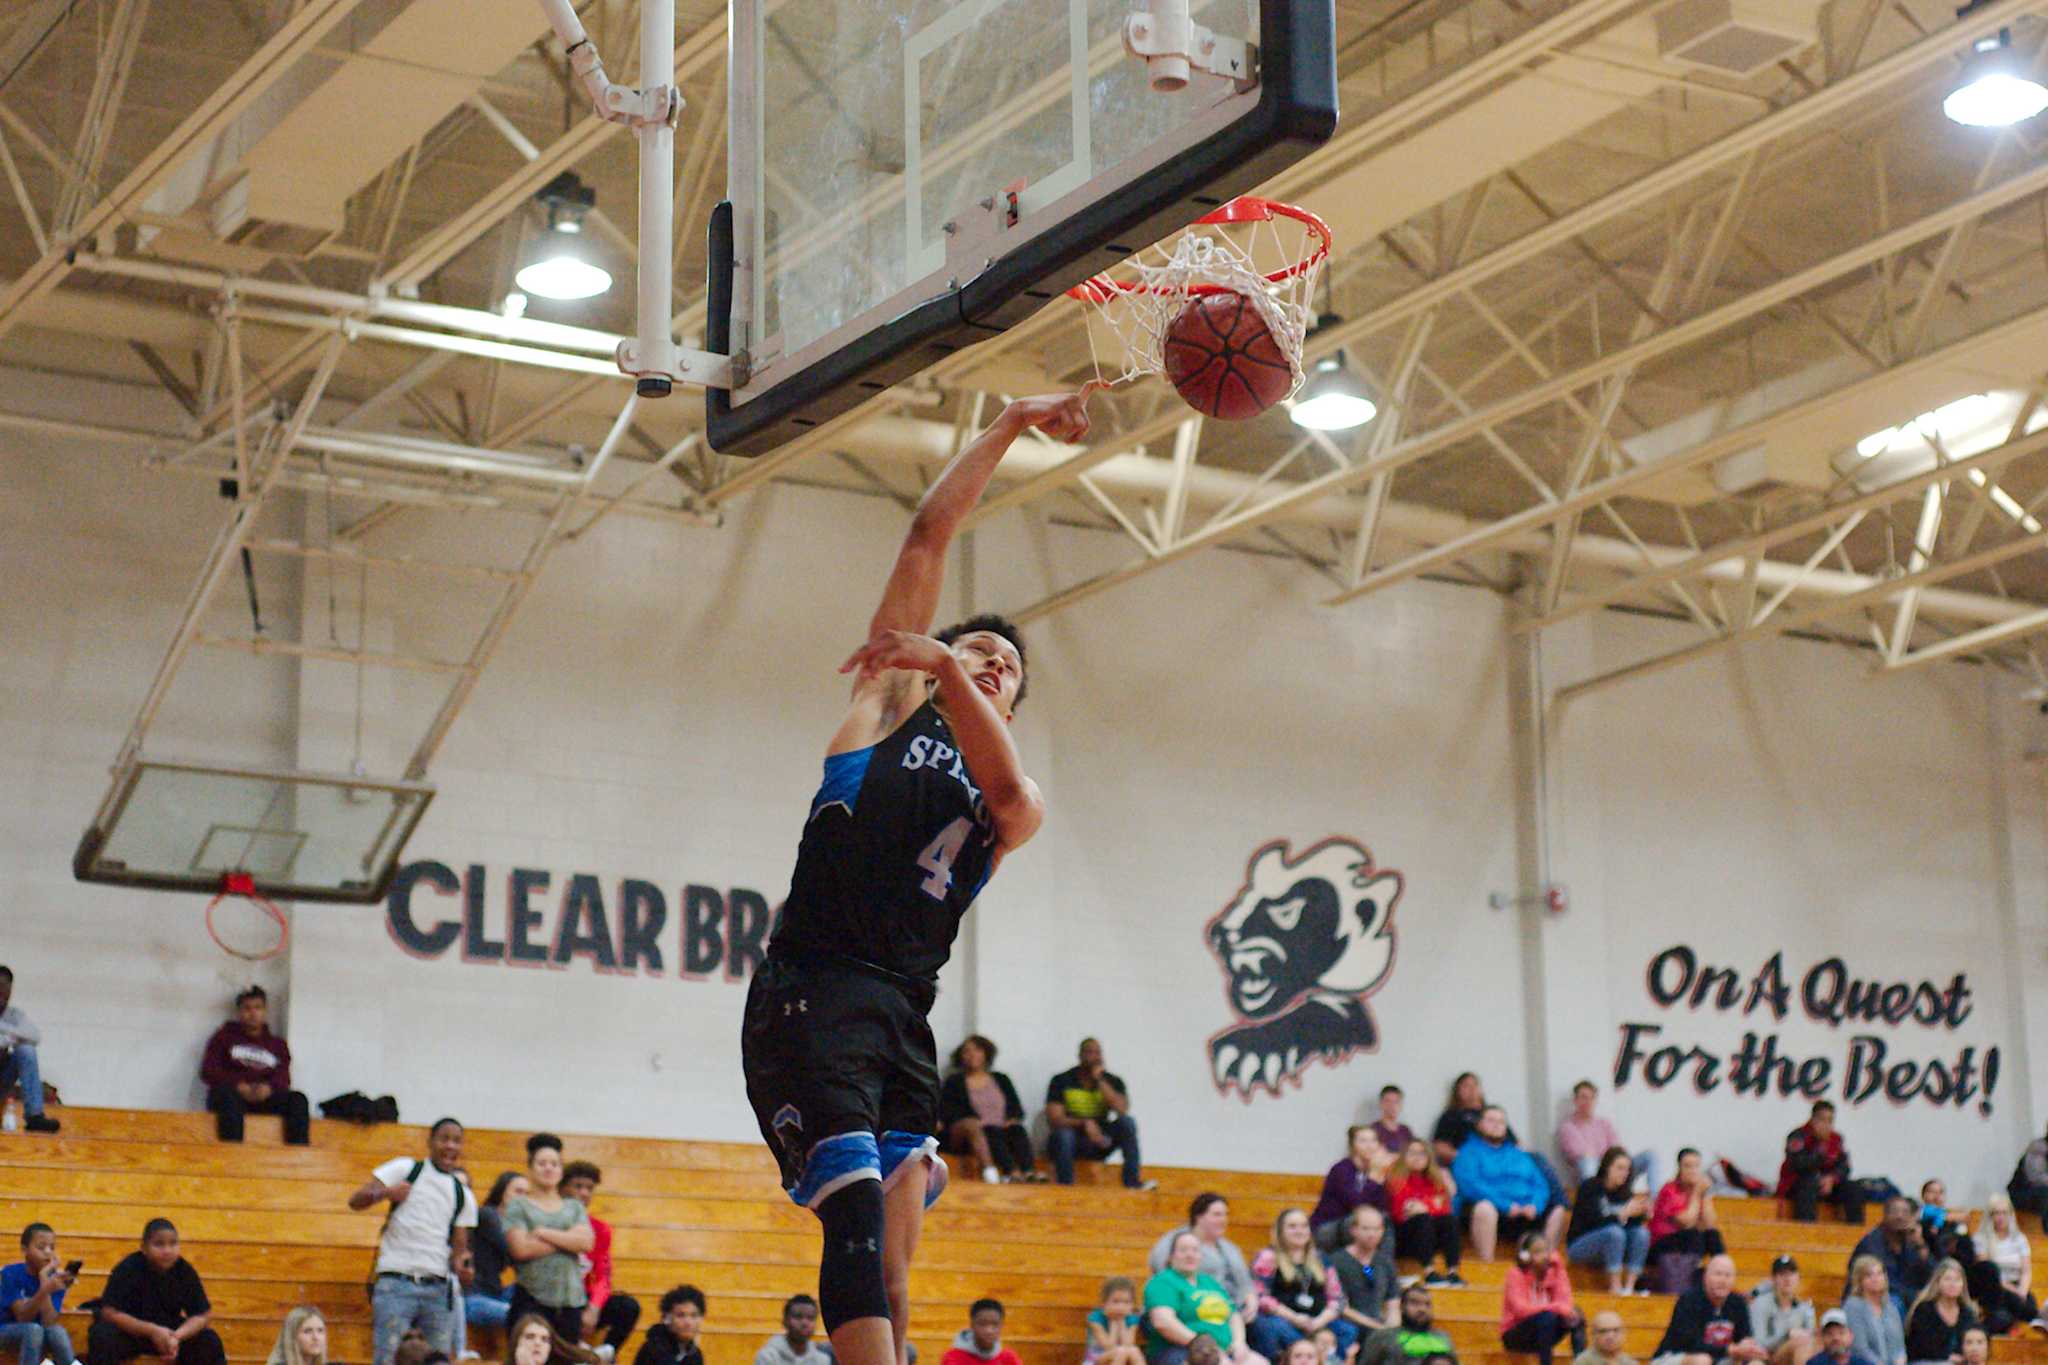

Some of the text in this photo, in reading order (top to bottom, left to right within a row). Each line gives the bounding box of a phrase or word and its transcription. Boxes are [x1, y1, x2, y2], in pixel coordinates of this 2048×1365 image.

[917, 815, 975, 902] 4
[385, 859, 786, 983] CLEAR BR
[1646, 944, 1973, 1029] On A Quest
[1614, 1022, 2000, 1118] For the Best!
